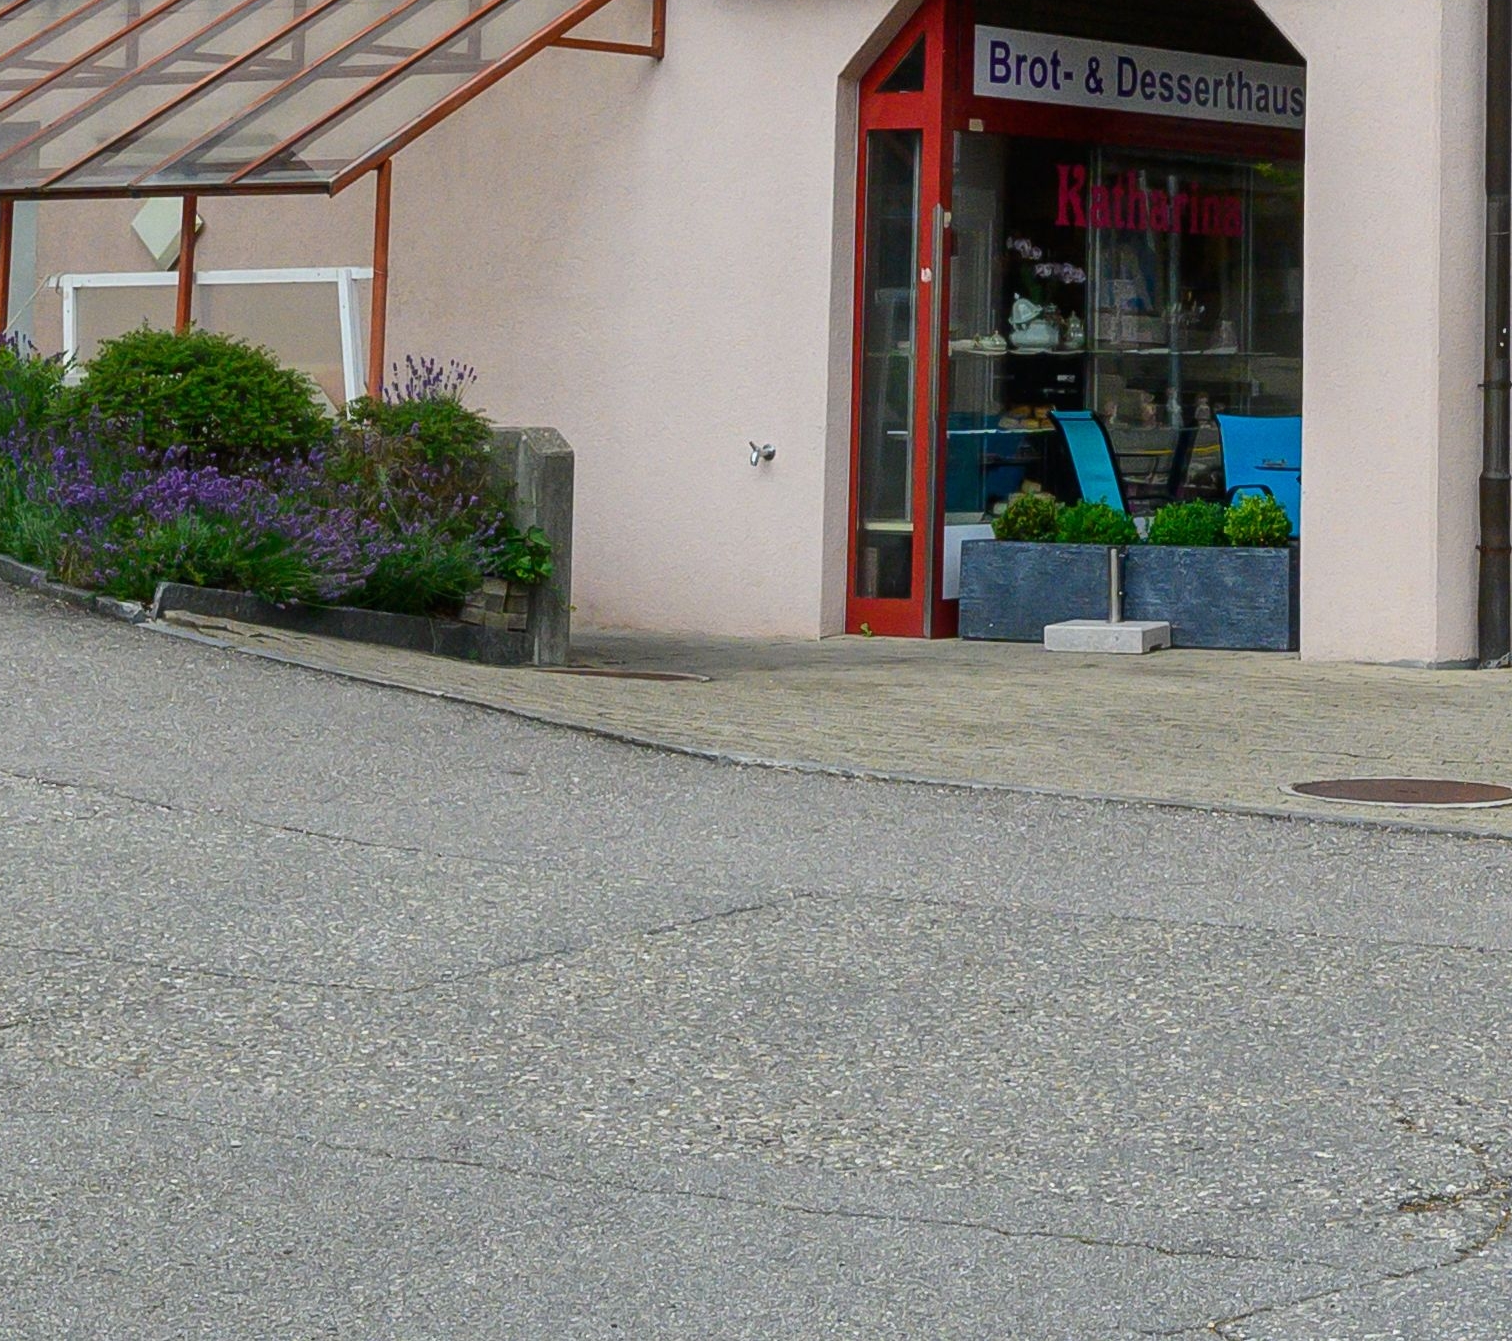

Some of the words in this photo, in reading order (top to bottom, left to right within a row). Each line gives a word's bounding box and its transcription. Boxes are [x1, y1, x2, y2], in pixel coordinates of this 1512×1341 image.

[989, 39, 1074, 91] Brot-
[1084, 56, 1105, 97] &
[1116, 55, 1305, 118] Desserthaus
[1054, 164, 1244, 237] Katharina
